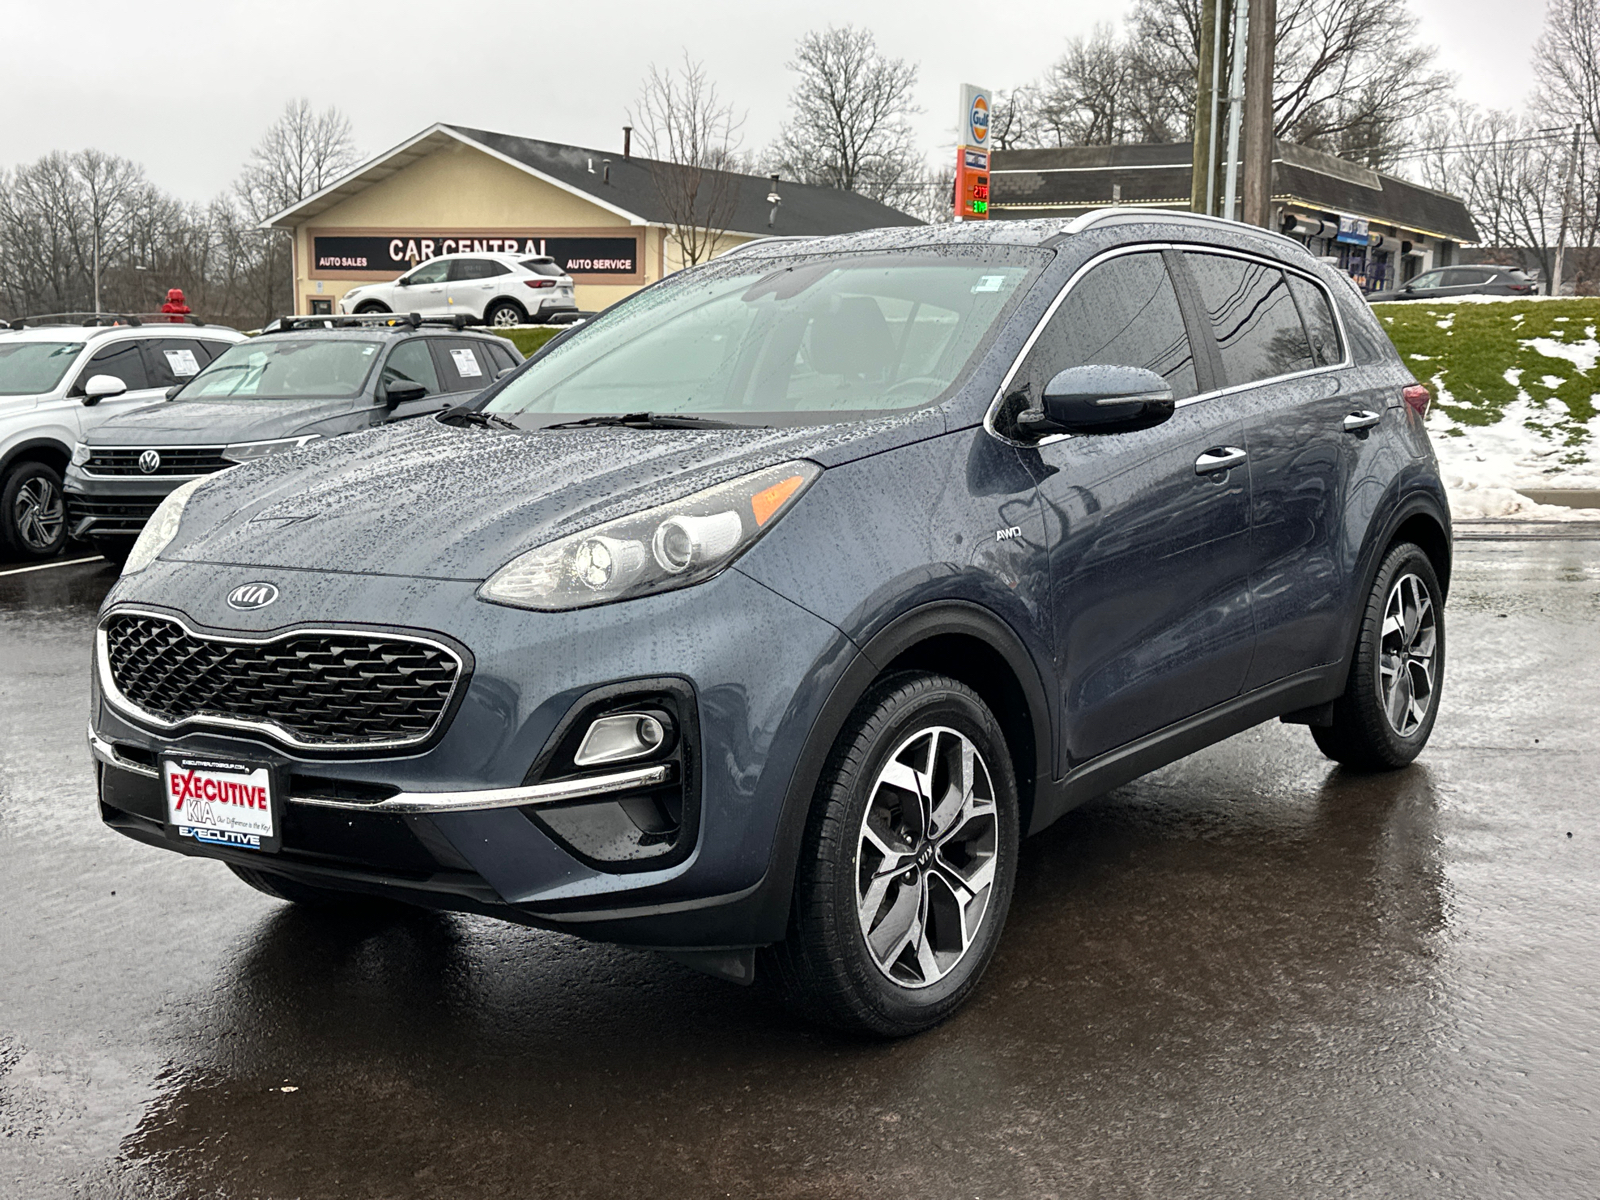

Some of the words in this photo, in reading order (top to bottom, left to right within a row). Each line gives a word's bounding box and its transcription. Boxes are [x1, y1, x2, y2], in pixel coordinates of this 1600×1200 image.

[973, 111, 989, 126] Gulf
[389, 239, 435, 261] CAR
[319, 257, 341, 267] AUTO
[341, 257, 368, 267] SALES
[566, 259, 592, 269] AUTO
[592, 259, 632, 270] SERVICE
[996, 526, 1021, 541] AWD
[231, 586, 269, 604] KIA
[170, 769, 268, 811] EXECUTIVE
[186, 799, 217, 826] KIA
[179, 826, 261, 846] EXECUTIVE
[260, 823, 271, 834] Key
